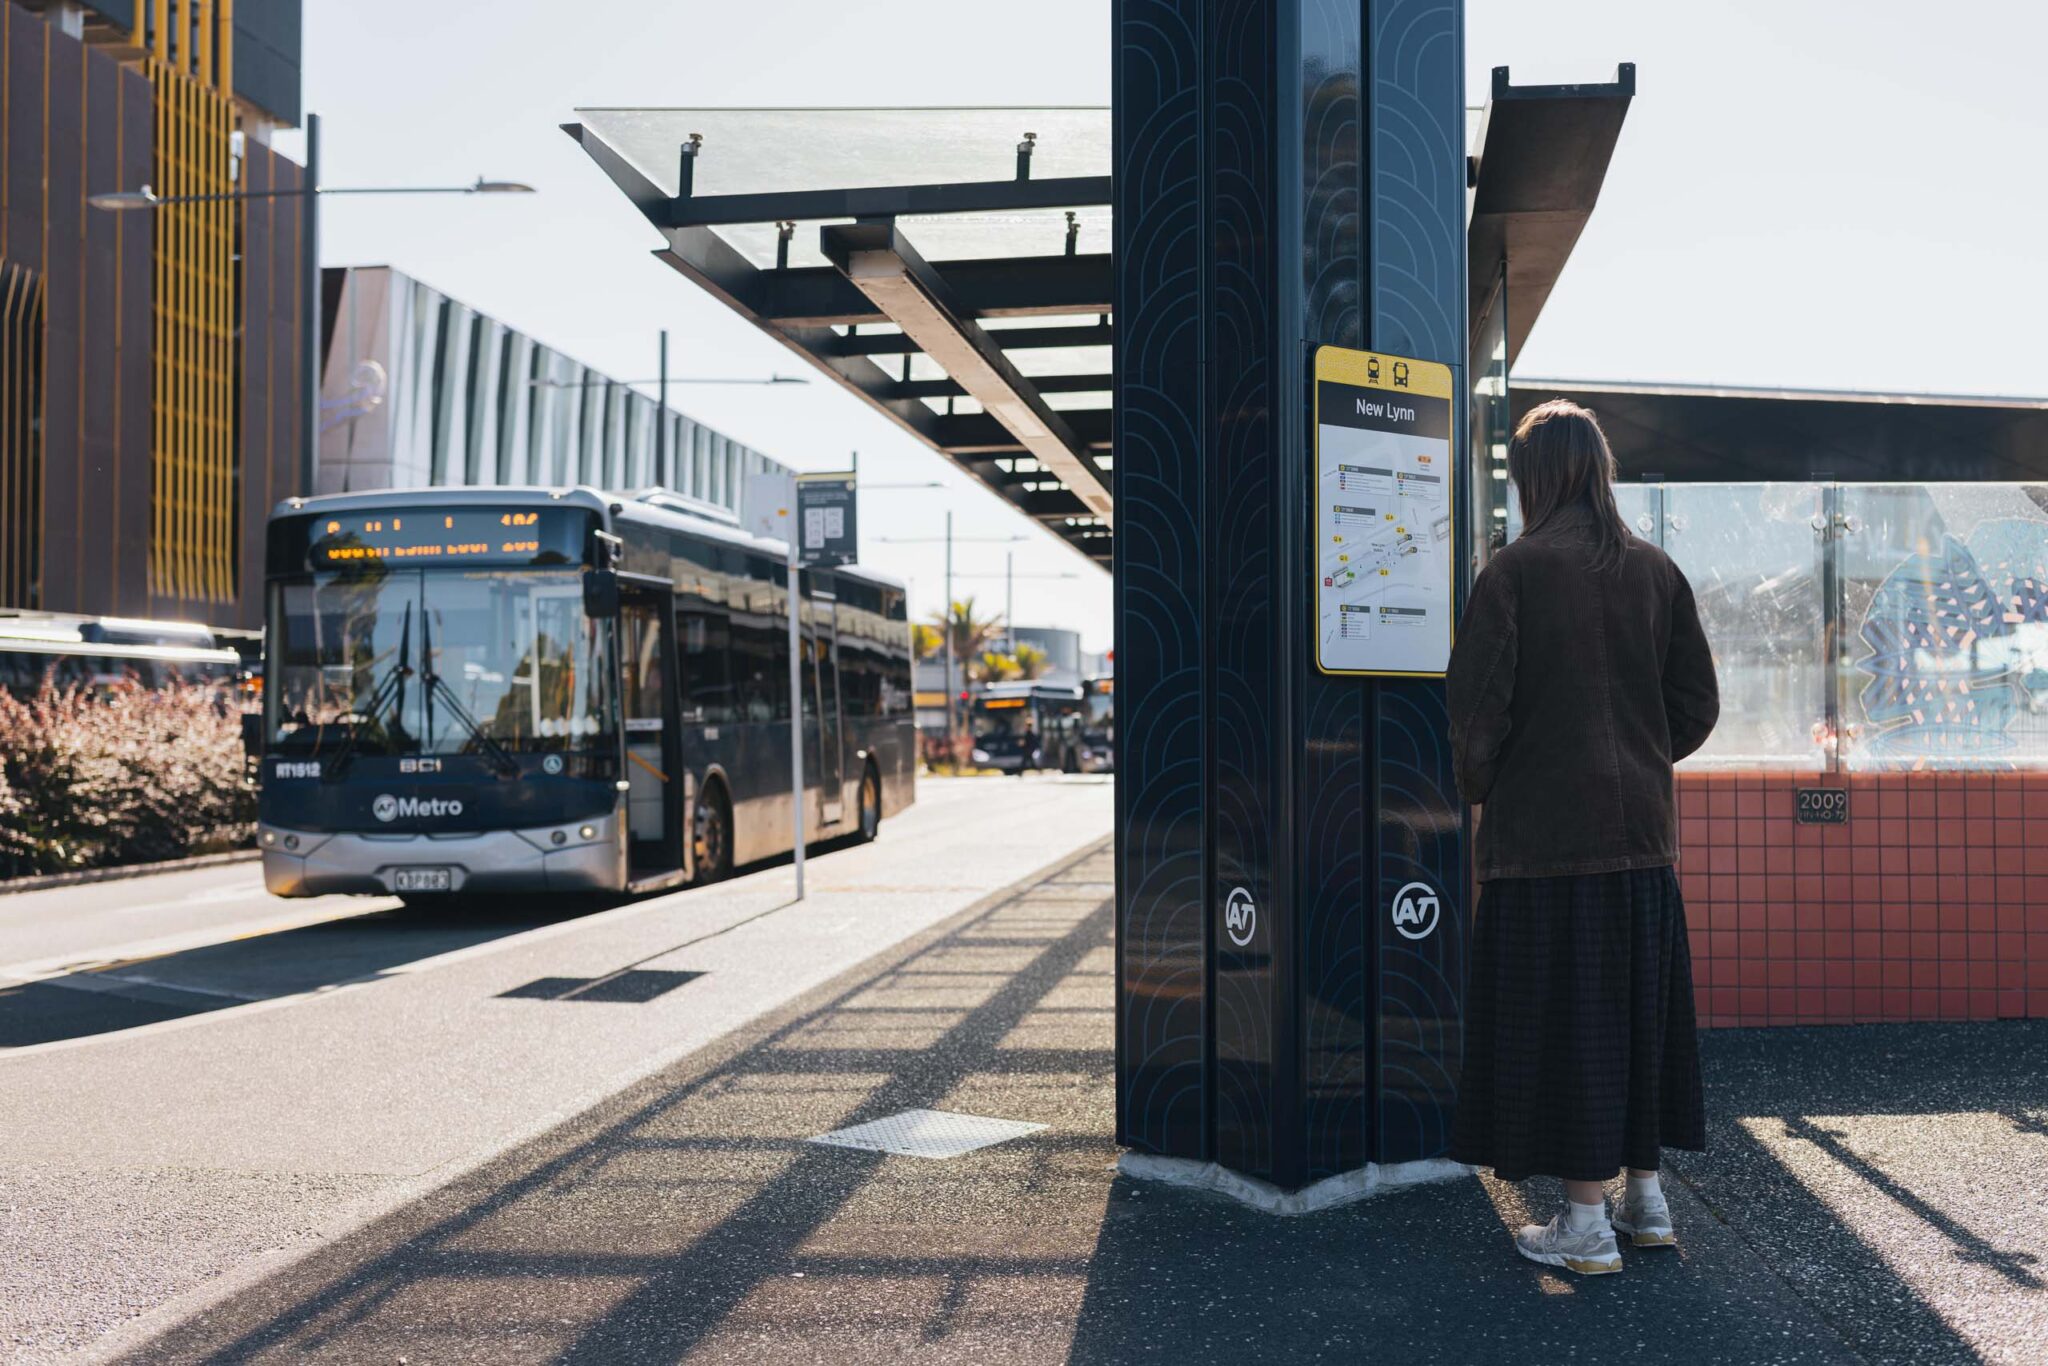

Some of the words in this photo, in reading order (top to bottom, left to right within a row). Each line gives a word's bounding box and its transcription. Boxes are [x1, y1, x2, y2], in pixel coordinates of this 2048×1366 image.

[1356, 398, 1384, 417] New
[1386, 402, 1415, 422] Lynn
[399, 758, 442, 773] BCI
[400, 797, 463, 817] Metro
[1800, 793, 1845, 810] 2009
